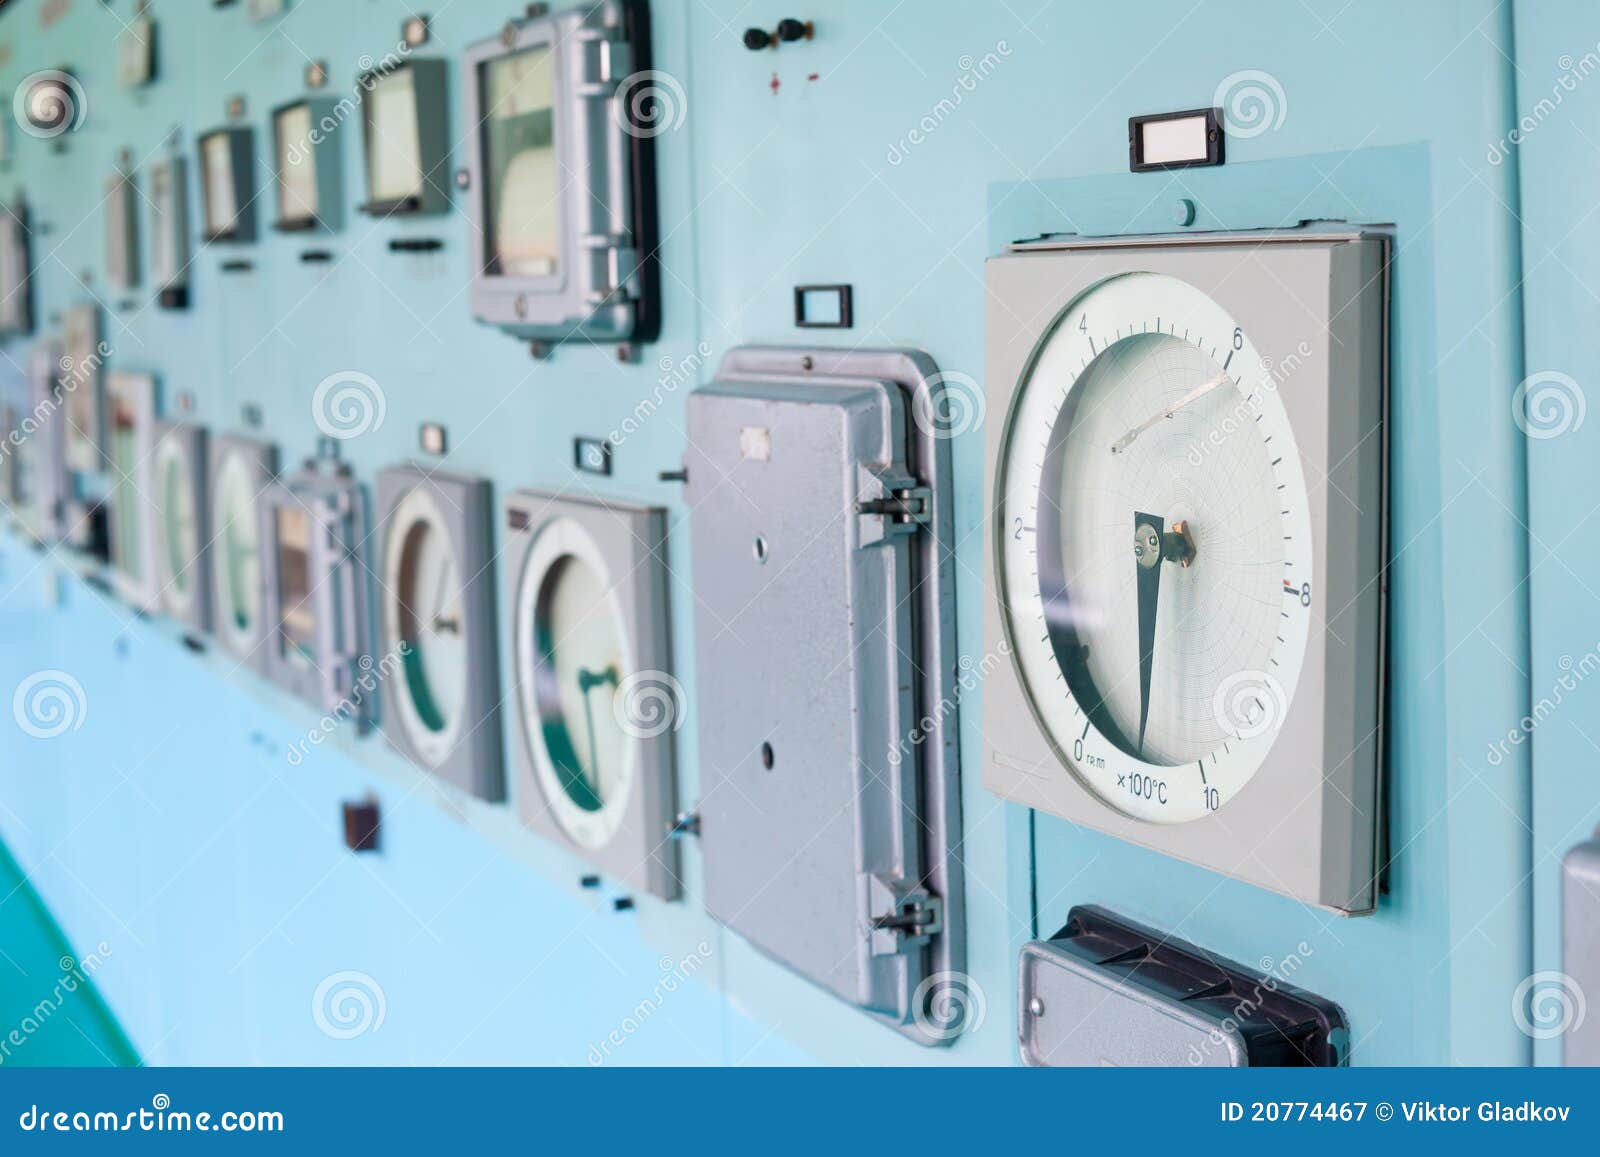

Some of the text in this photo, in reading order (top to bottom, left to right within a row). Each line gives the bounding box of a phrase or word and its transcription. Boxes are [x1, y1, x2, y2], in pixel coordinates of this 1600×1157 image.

[1079, 311, 1088, 335] 4
[1233, 326, 1243, 351] 6
[1014, 516, 1023, 540] 2
[1300, 582, 1311, 607] 8
[1074, 738, 1083, 762] 0
[1203, 786, 1219, 811] 10
